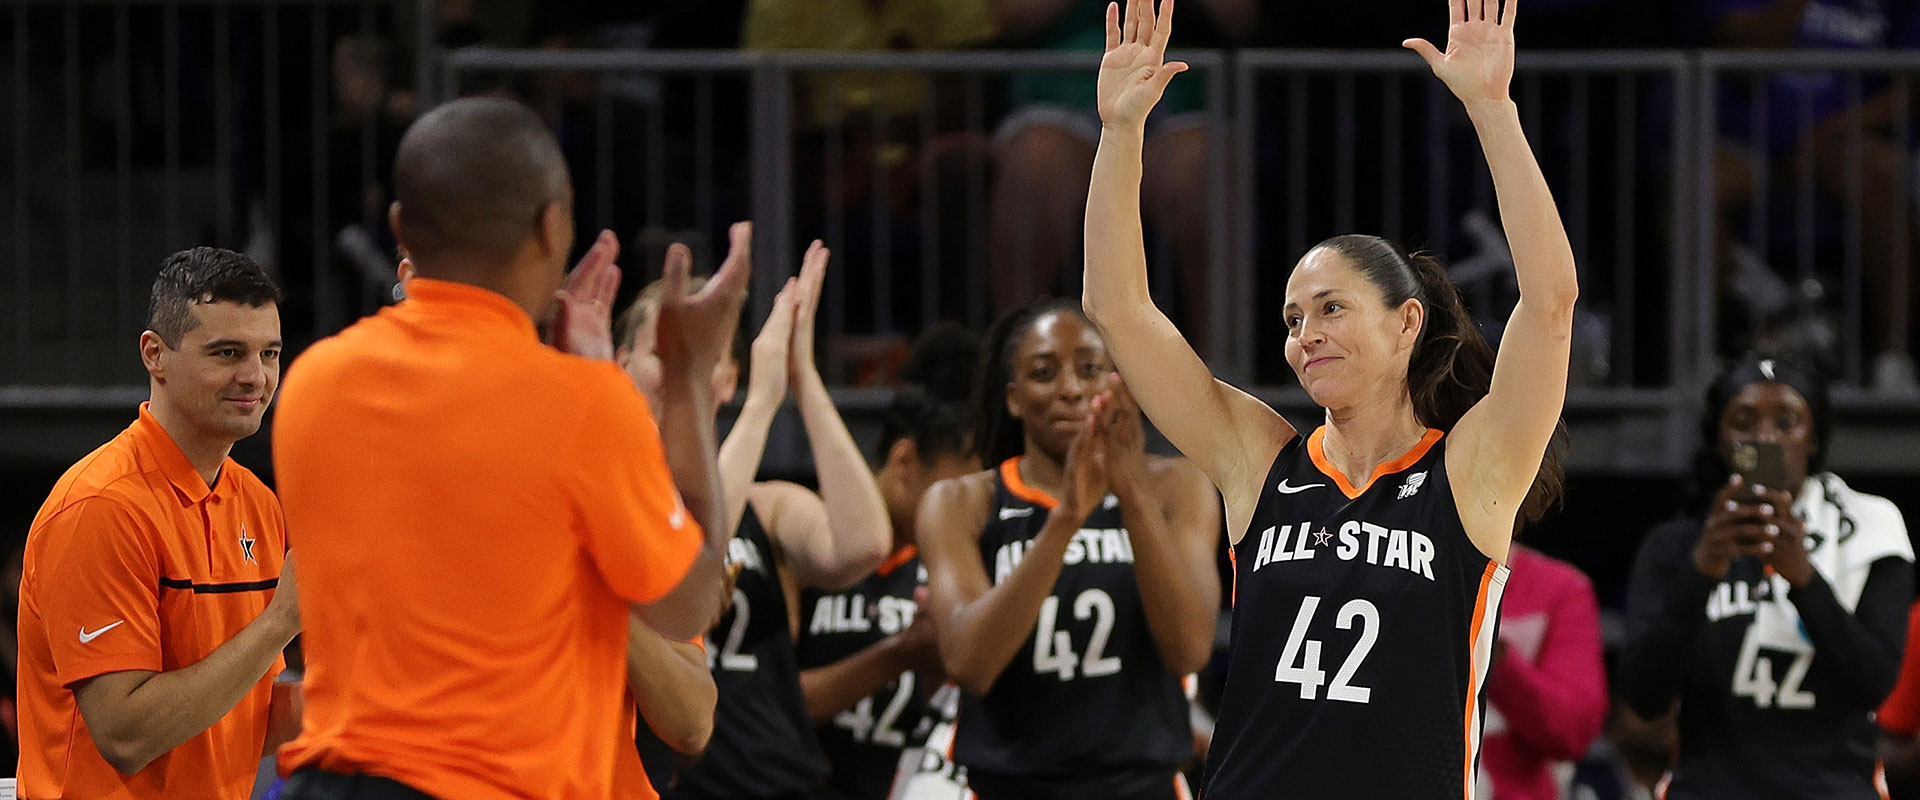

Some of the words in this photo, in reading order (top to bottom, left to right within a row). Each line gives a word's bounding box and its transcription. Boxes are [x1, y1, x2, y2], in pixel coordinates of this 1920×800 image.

[1253, 521, 1316, 572] ALL
[1336, 520, 1436, 581] STAR
[809, 593, 872, 635] ALL
[1032, 588, 1122, 681] 42
[1275, 595, 1380, 704] 42
